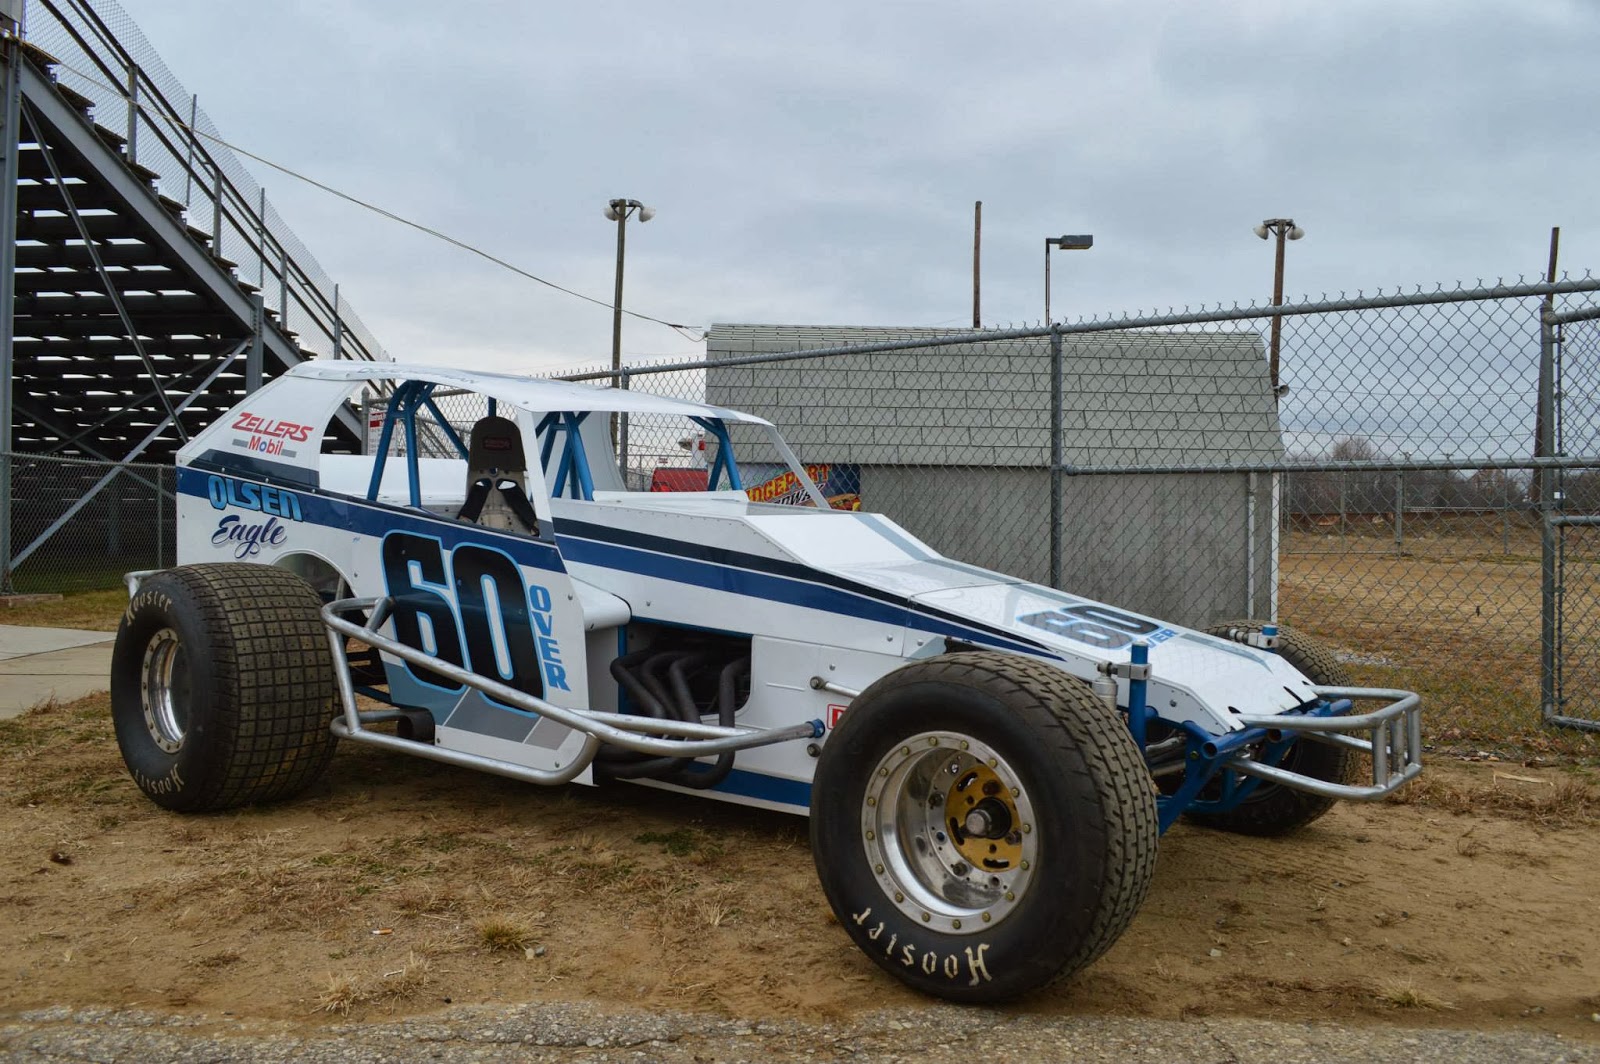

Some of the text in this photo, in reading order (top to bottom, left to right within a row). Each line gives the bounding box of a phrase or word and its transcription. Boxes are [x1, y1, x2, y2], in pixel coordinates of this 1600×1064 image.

[231, 411, 314, 442] ZELLERS
[248, 435, 284, 456] Mobil
[207, 474, 304, 522] OLSEN
[746, 464, 832, 503] DGEPRT
[211, 514, 288, 559] Eagle
[380, 529, 549, 717] 60
[529, 584, 572, 692] OVER
[1016, 603, 1164, 651] 60
